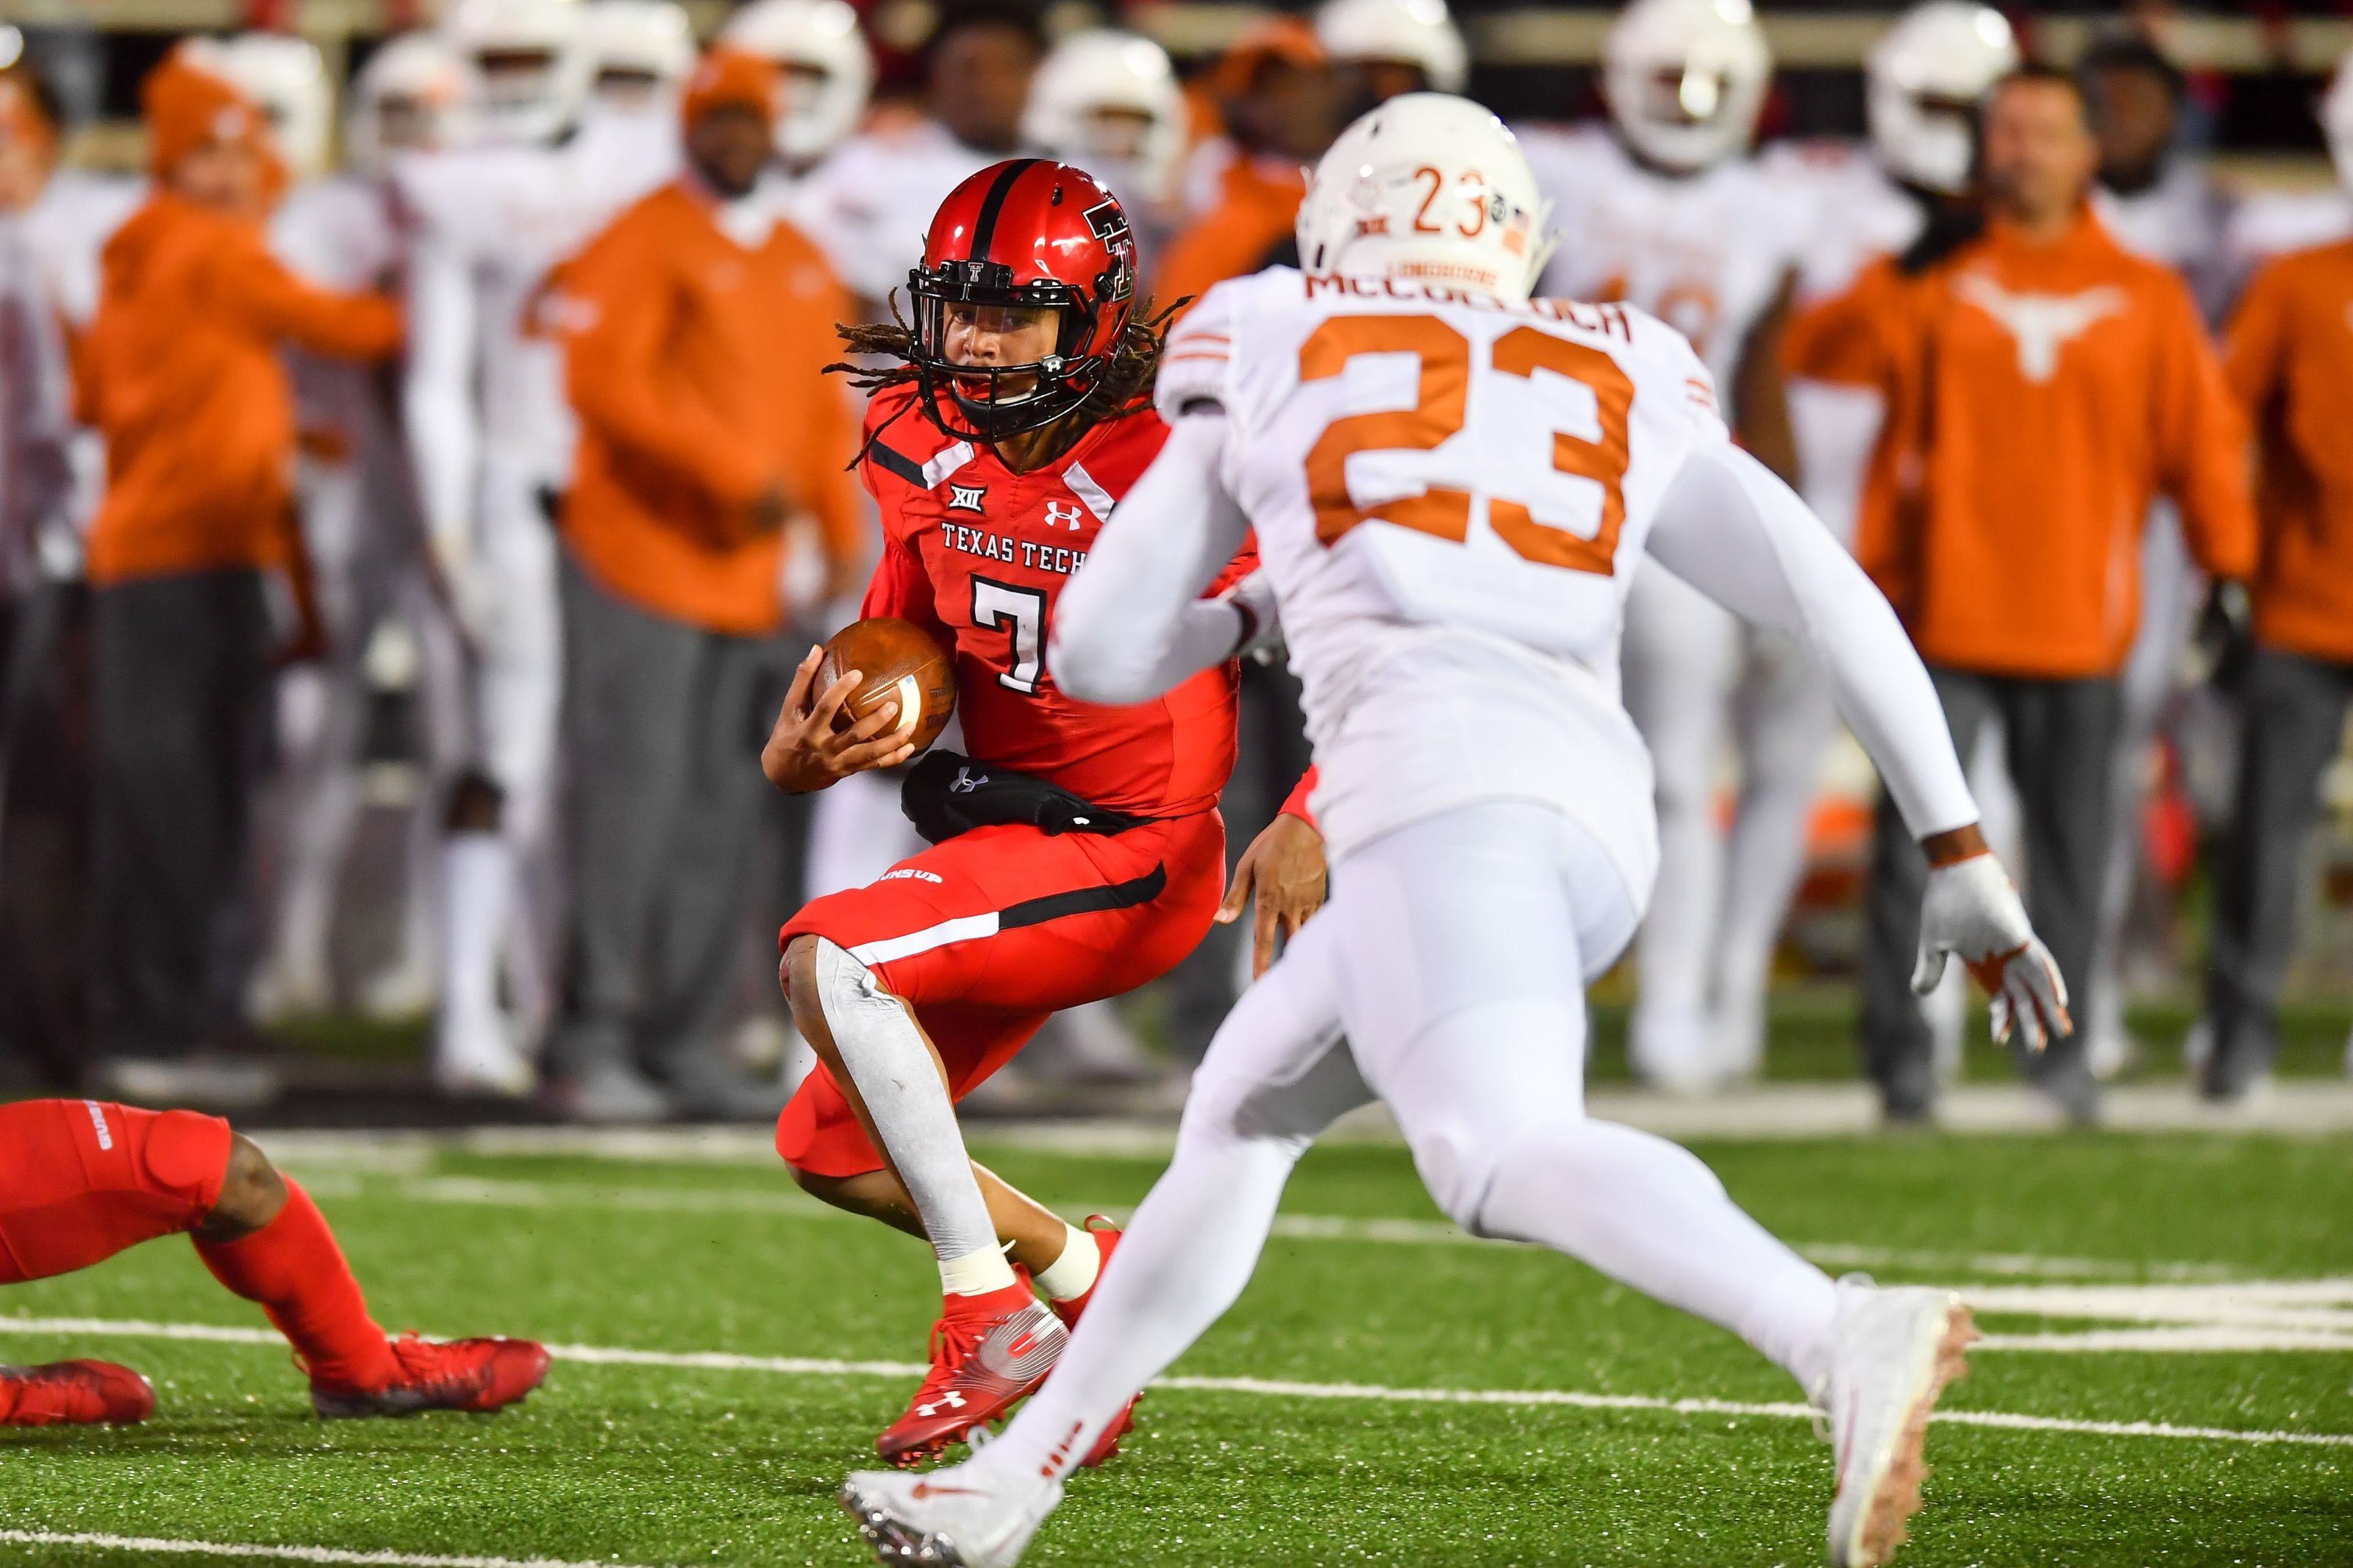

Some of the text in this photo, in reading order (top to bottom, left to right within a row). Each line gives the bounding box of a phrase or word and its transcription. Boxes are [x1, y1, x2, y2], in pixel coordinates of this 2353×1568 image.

[1413, 167, 1485, 237] 23
[1299, 314, 1635, 577] 23
[940, 521, 1088, 576] TEXAS TECH
[970, 573, 1047, 695] 7
[879, 869, 943, 884] UNS UP
